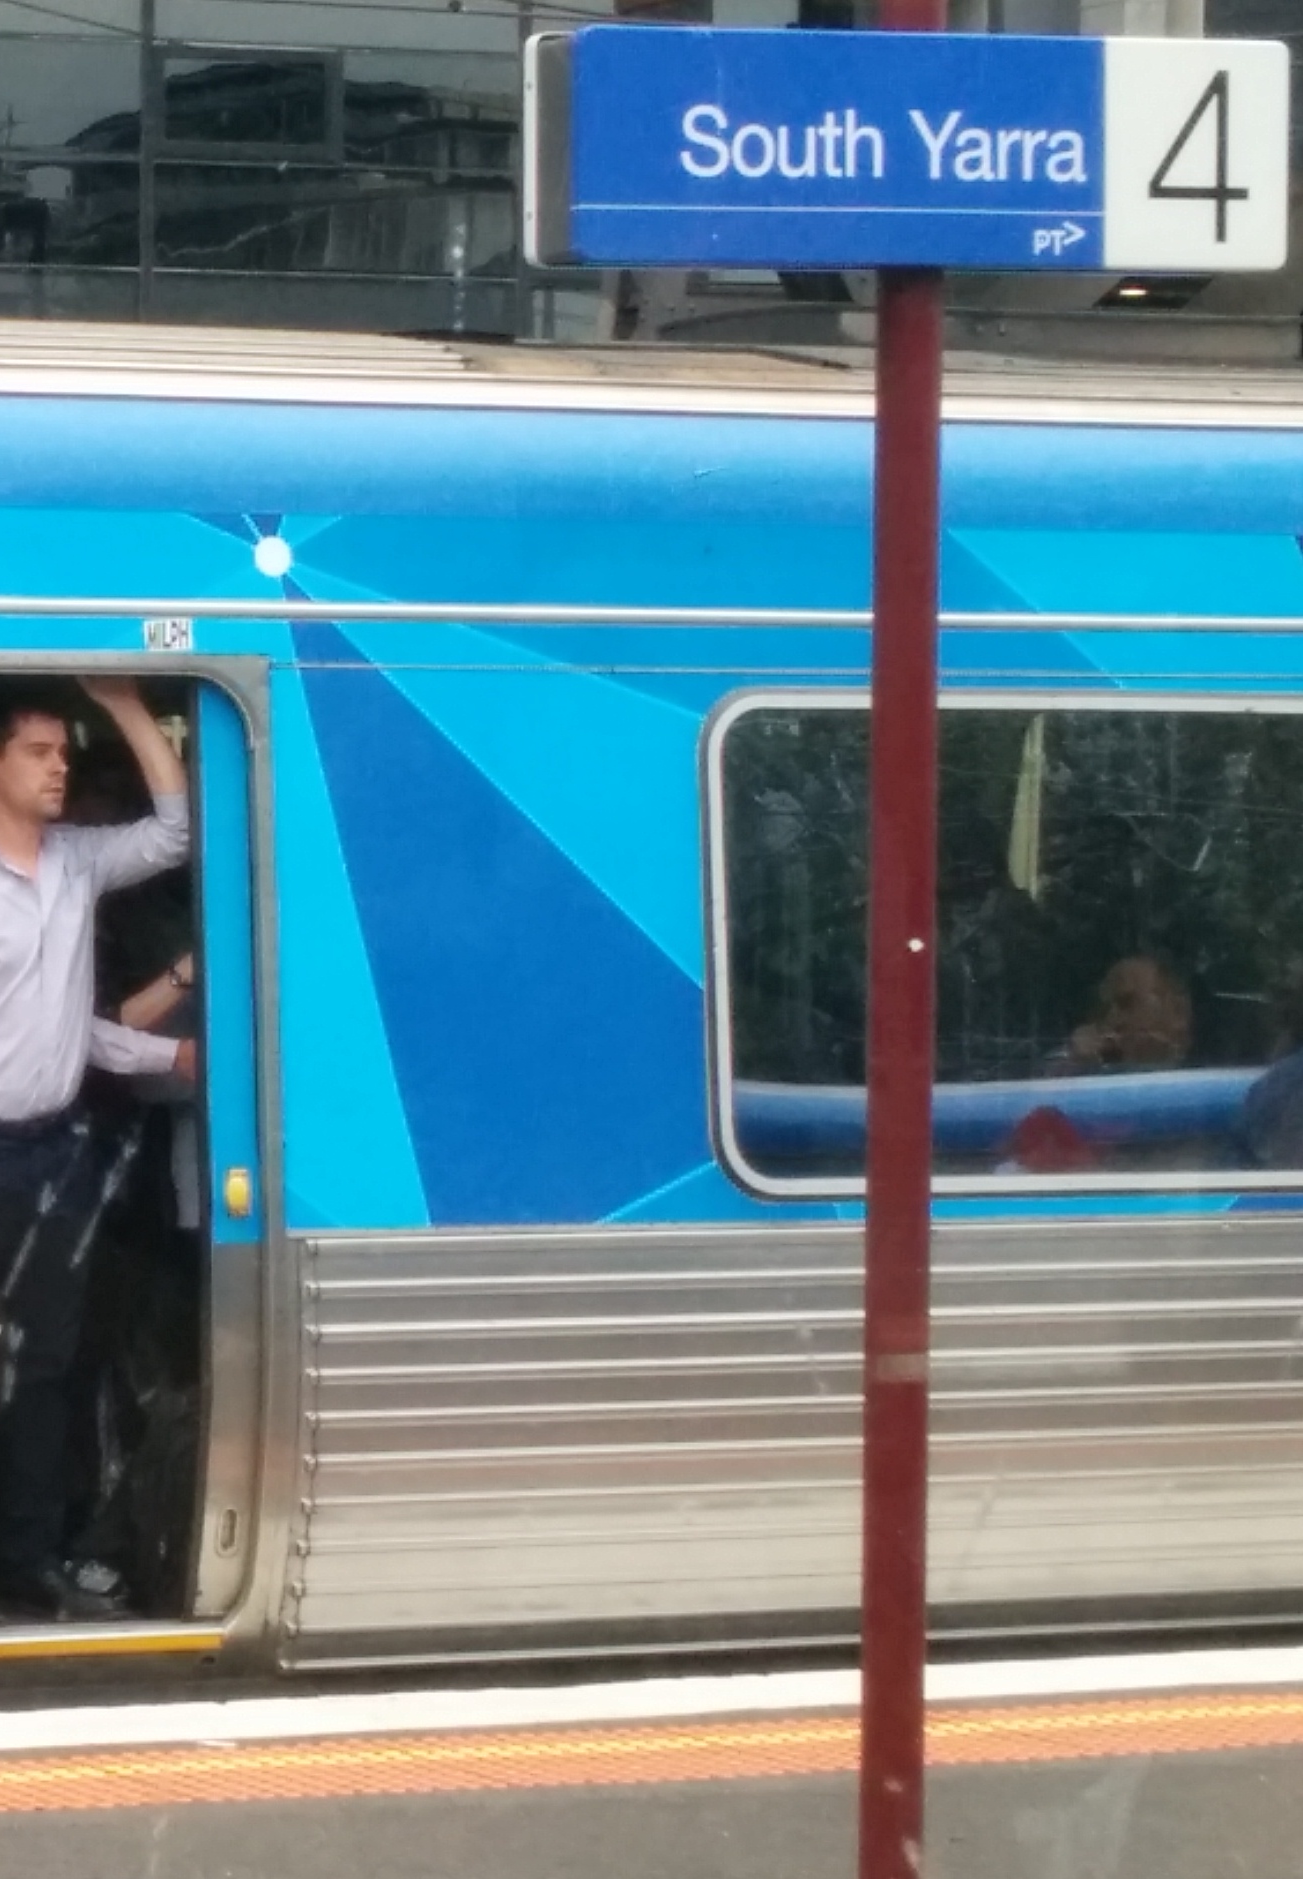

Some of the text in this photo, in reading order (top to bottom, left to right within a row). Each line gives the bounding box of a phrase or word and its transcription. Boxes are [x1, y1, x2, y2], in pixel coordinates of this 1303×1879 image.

[680, 103, 1088, 183] South Yarra
[1148, 69, 1249, 243] 4
